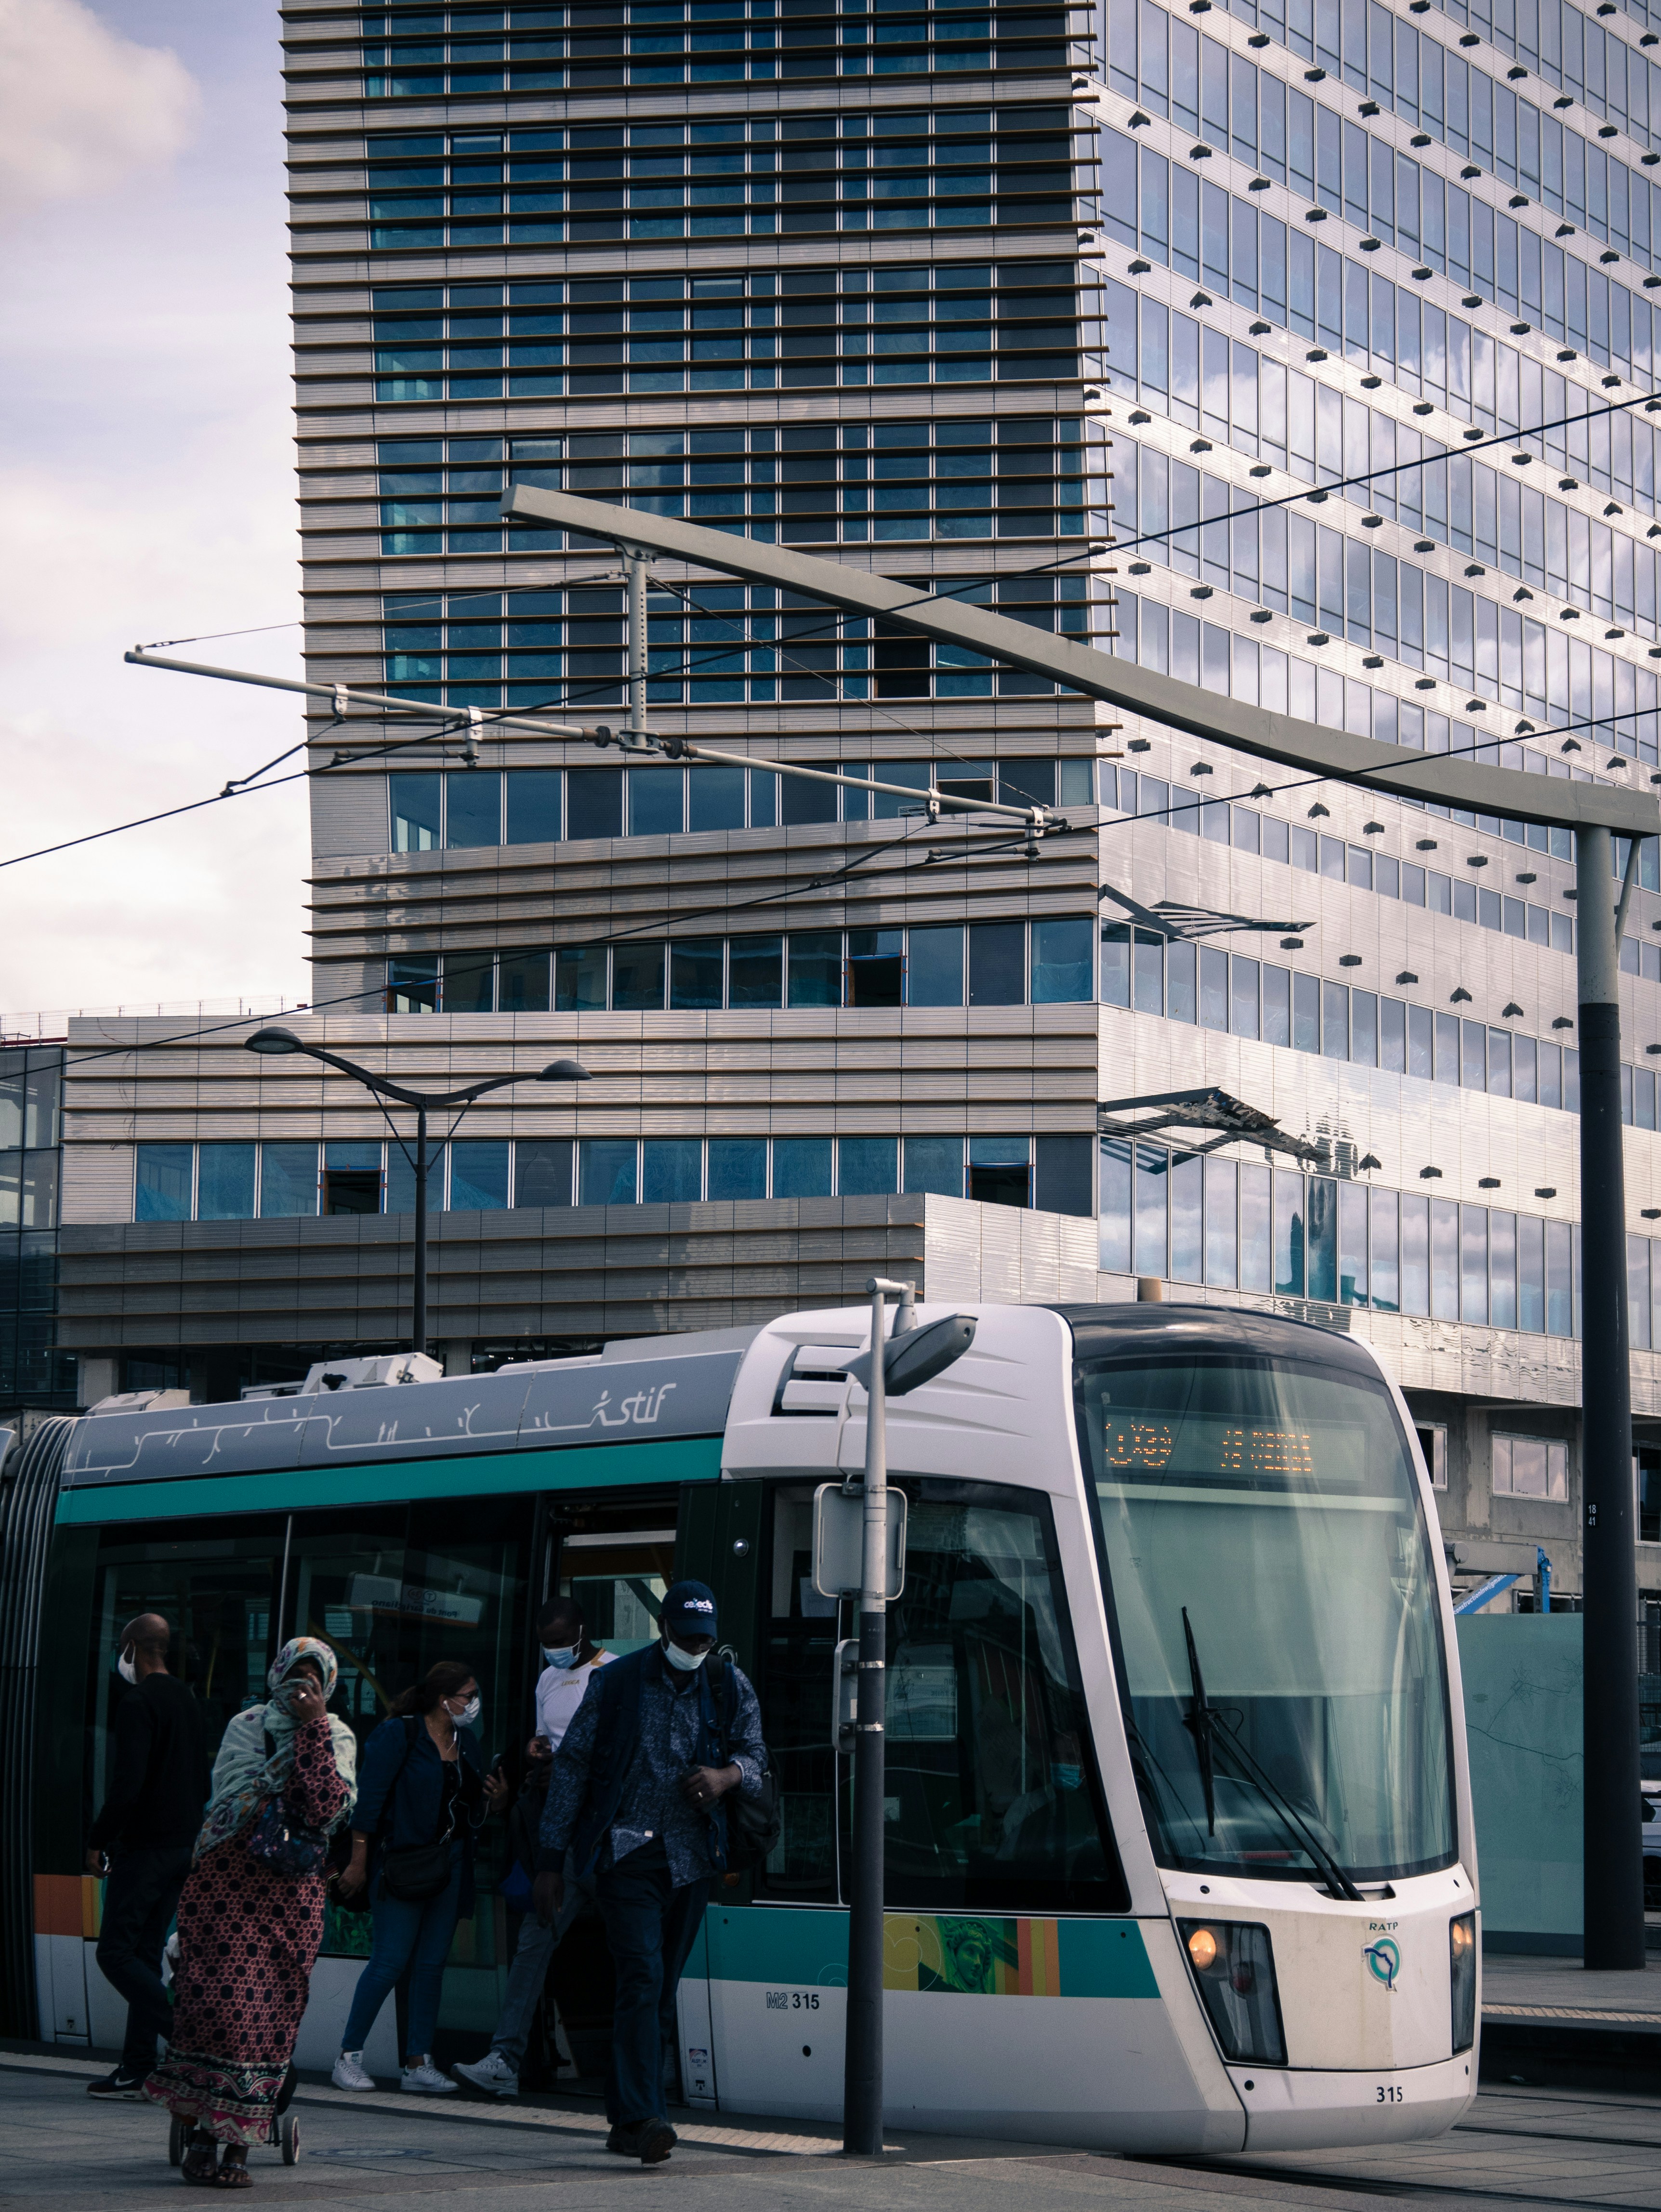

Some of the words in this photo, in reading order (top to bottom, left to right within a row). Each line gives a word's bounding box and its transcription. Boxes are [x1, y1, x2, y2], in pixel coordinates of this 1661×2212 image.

[1588, 1504, 1596, 1514] 18
[1588, 1516, 1595, 1526] 41
[1369, 1922, 1398, 1931] RATP
[766, 1991, 788, 2010] M2
[792, 1993, 820, 2010] 315
[1376, 2086, 1403, 2103] 315
